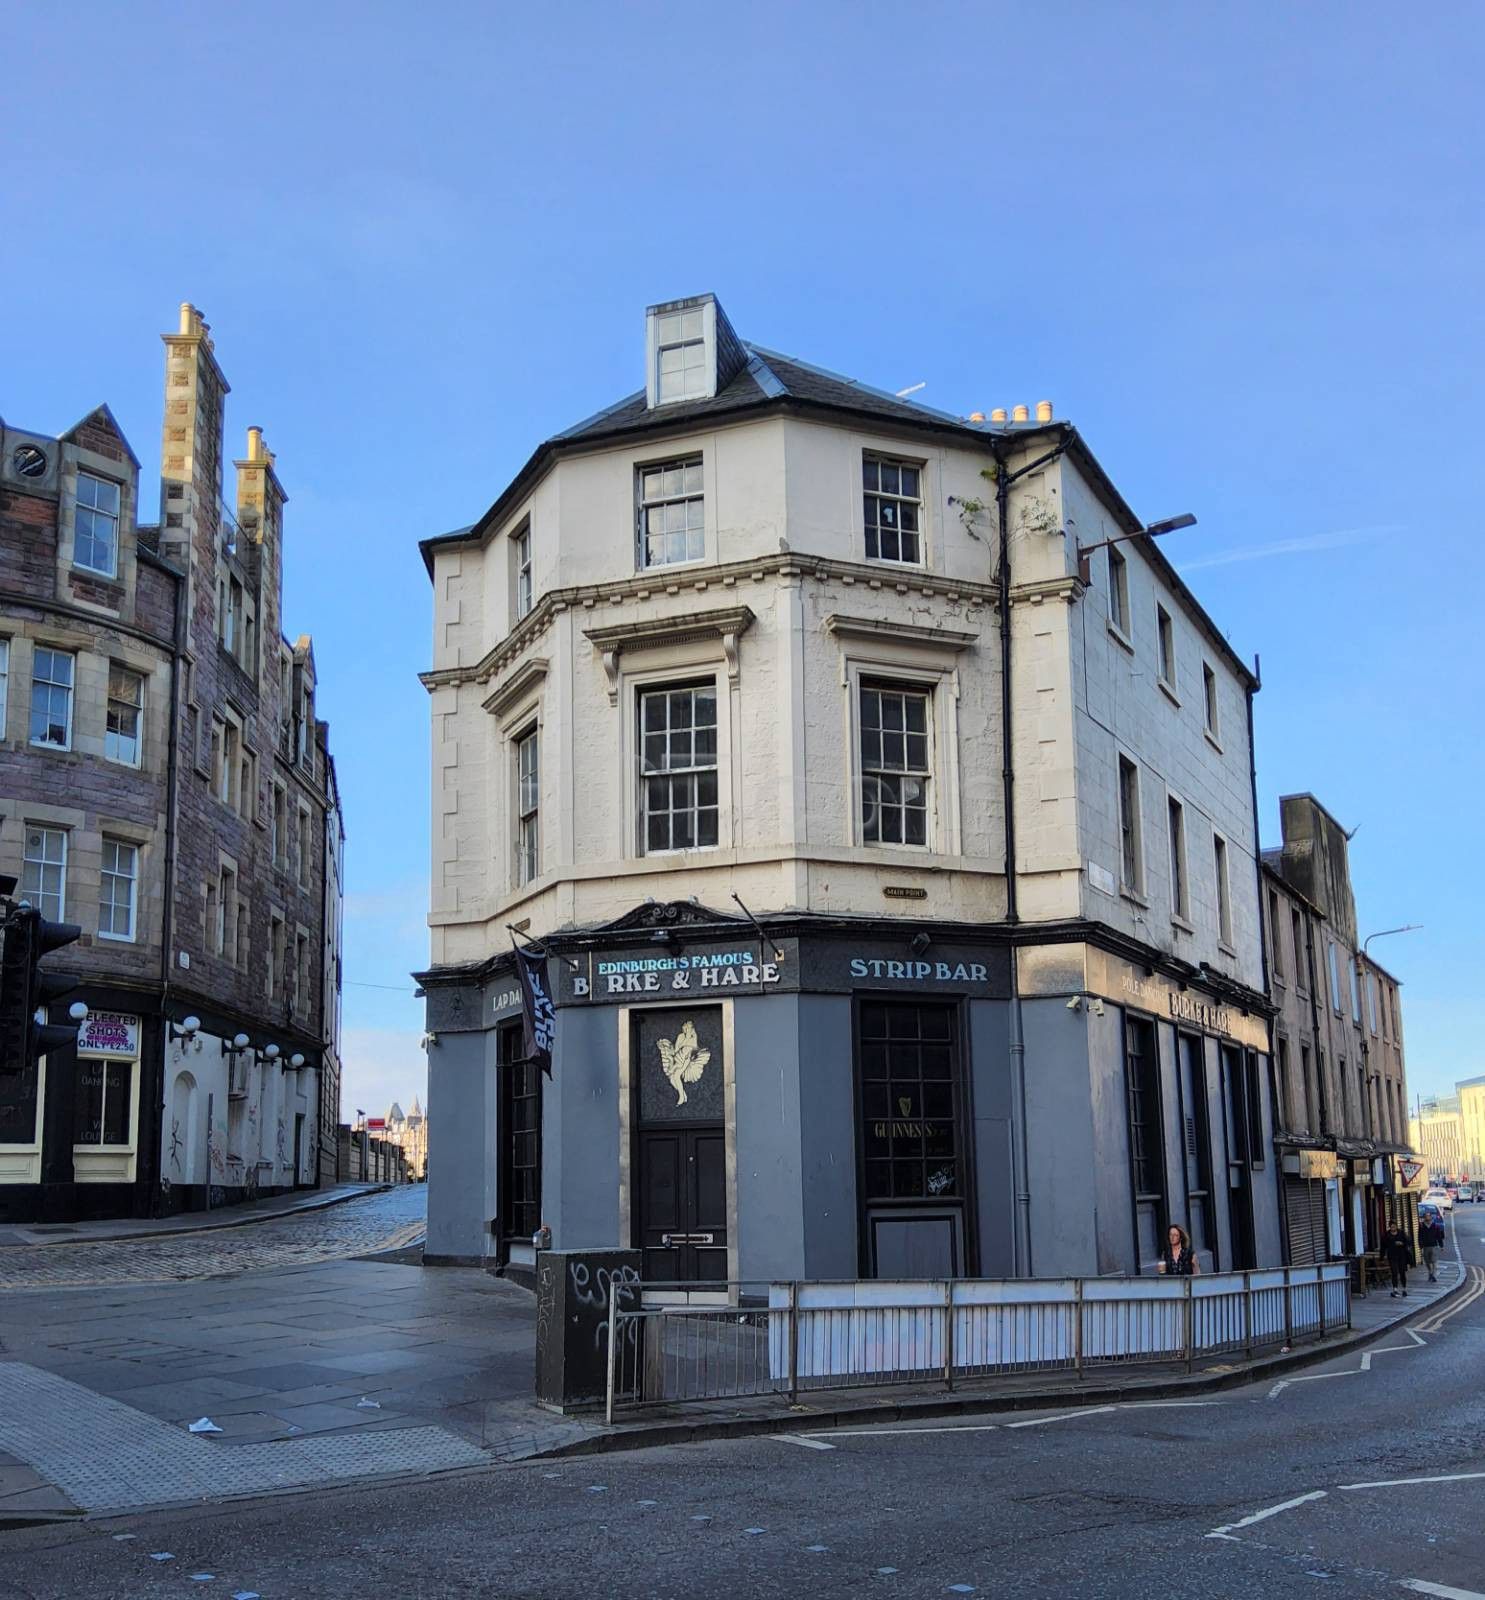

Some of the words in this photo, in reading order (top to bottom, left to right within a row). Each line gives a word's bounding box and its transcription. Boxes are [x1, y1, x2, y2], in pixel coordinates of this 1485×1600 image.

[886, 888, 904, 896] MAIN
[905, 889, 924, 897] POINT
[598, 957, 690, 974] EDINBURGH'S
[692, 952, 753, 967] FAMOUS
[850, 959, 932, 979] STRIP
[935, 962, 988, 981] BAR
[672, 970, 690, 990] &
[700, 963, 780, 987] HARE
[1122, 976, 1139, 996] POLE
[493, 993, 508, 1012] LAP
[86, 1012, 137, 1026] ELECTED
[1171, 993, 1202, 1025] BURKE
[1203, 1005, 1210, 1027] &
[1210, 1007, 1232, 1034] HARE
[88, 1025, 128, 1038] SHOTS
[78, 1039, 106, 1049] ONLY
[110, 1041, 135, 1052] £2.50
[875, 1122, 934, 1138] GUINNESS
